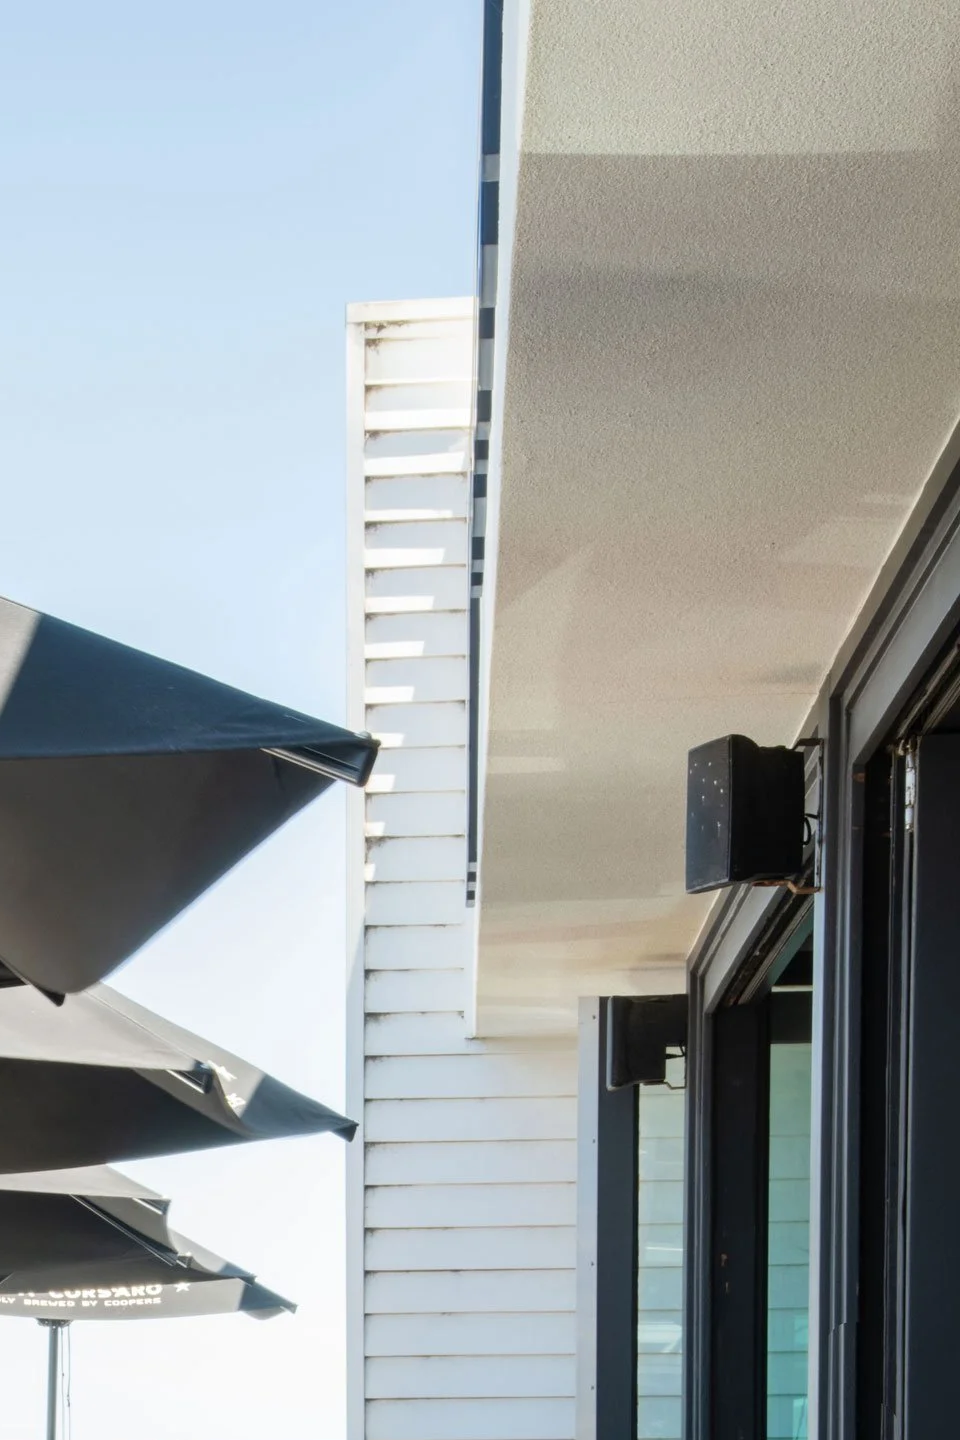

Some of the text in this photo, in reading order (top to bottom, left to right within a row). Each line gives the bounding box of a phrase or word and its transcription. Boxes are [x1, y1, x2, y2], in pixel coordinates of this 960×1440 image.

[24, 1298, 75, 1307] BREWED
[82, 1299, 98, 1307] BY
[104, 1297, 162, 1307] COOPERS
